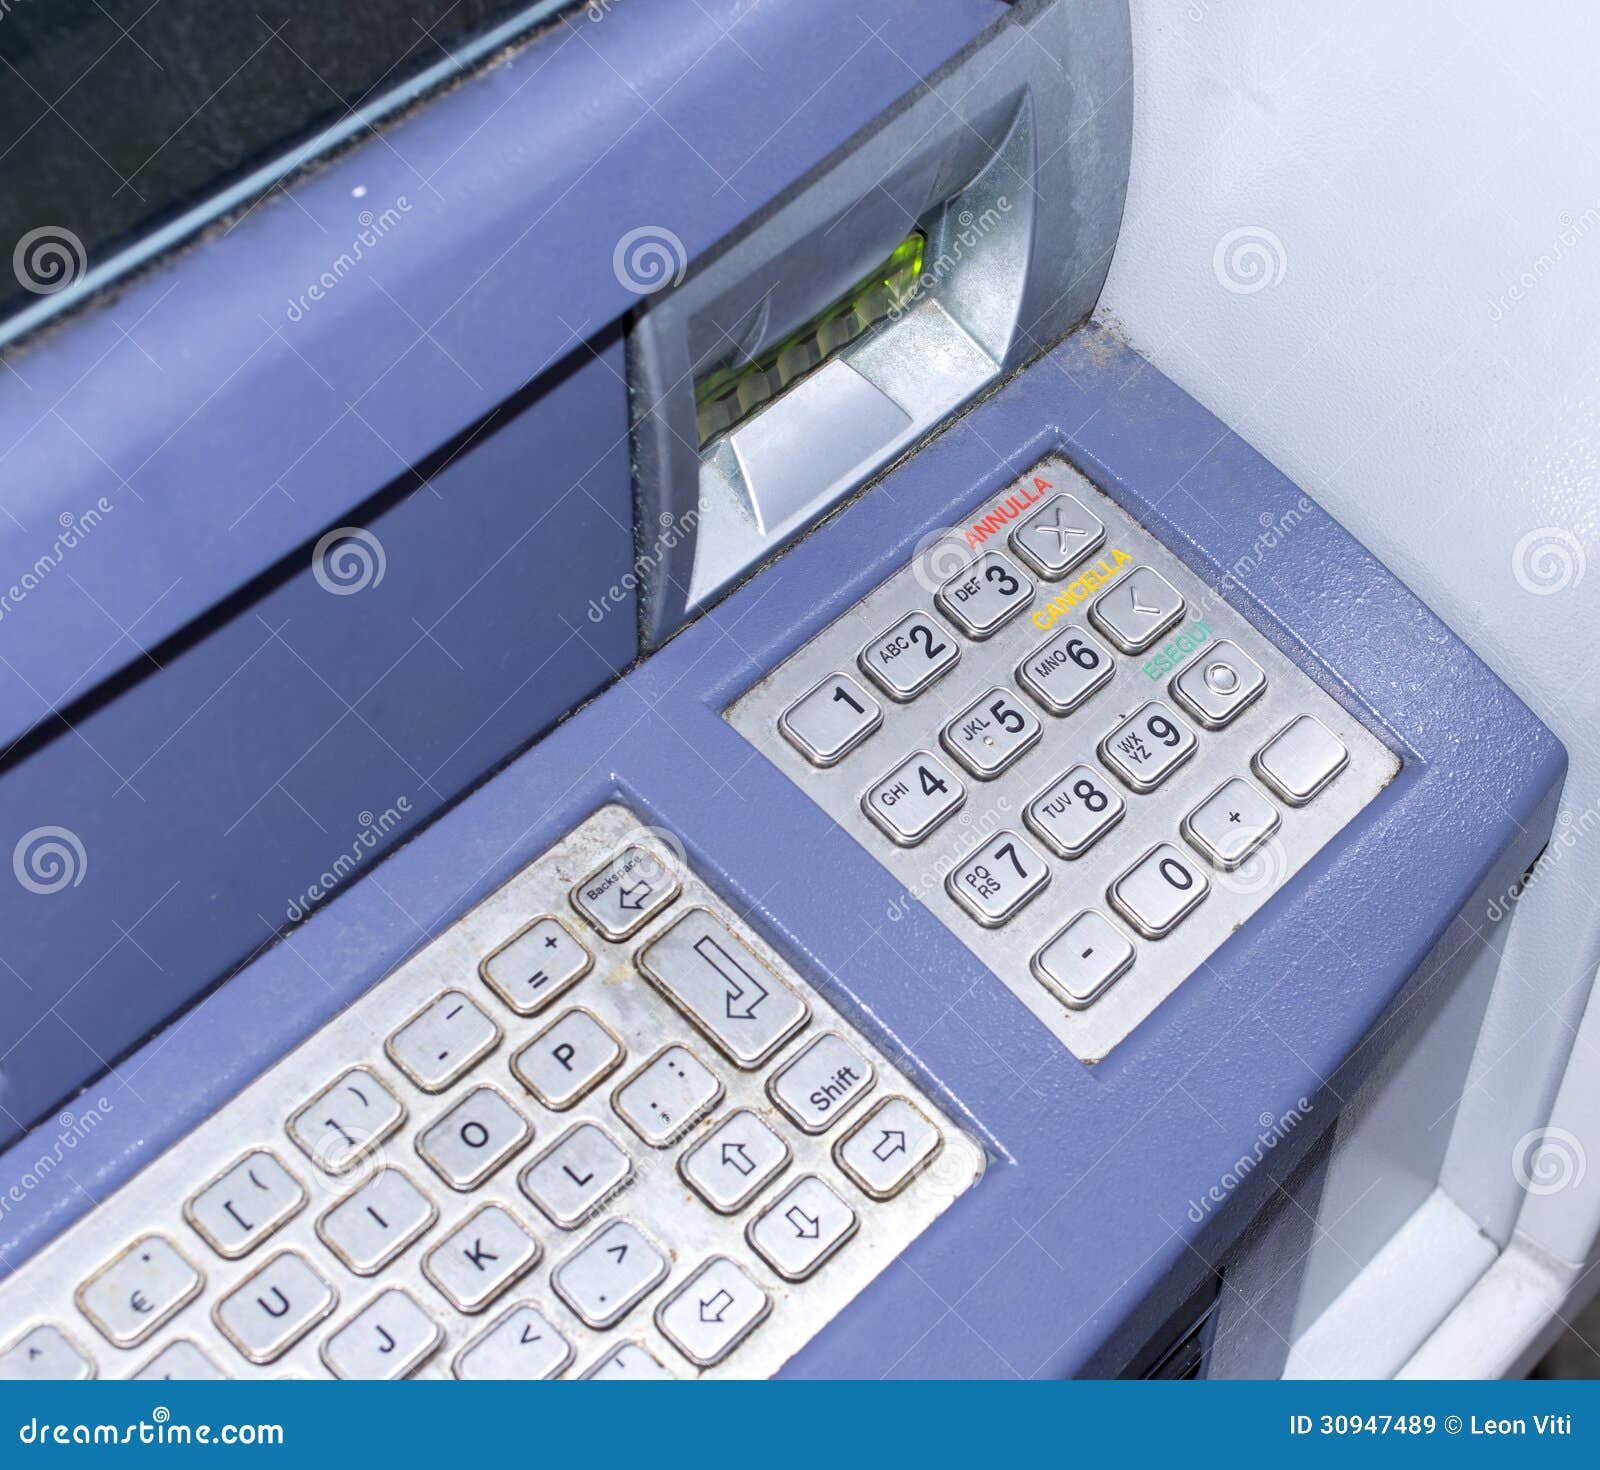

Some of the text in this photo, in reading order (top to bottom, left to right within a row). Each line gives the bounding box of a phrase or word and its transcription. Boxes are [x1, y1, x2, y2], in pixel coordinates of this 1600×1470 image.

[965, 477, 1053, 550] ANNULLA
[954, 565, 1020, 603] DEF 3
[1031, 548, 1134, 631] CANCELLA
[878, 624, 947, 664] ABC 2
[1034, 639, 1100, 678] MNO 6
[1142, 619, 1215, 682] ESEGUI
[833, 686, 865, 714] 1
[961, 700, 1025, 742] JKL 5
[1116, 715, 1181, 755] WX 9
[1128, 743, 1153, 764] YZ
[881, 765, 949, 807] GHI 4
[1041, 780, 1108, 820] TUV 8
[965, 842, 1028, 888] PQ 7
[977, 877, 1001, 900] RS
[551, 1042, 576, 1072] P
[809, 1066, 860, 1112] Shift
[460, 1121, 489, 1148] O
[562, 1165, 594, 1188] L
[463, 1238, 499, 1271] K
[257, 1286, 290, 1317] U
[375, 1324, 396, 1353] J
